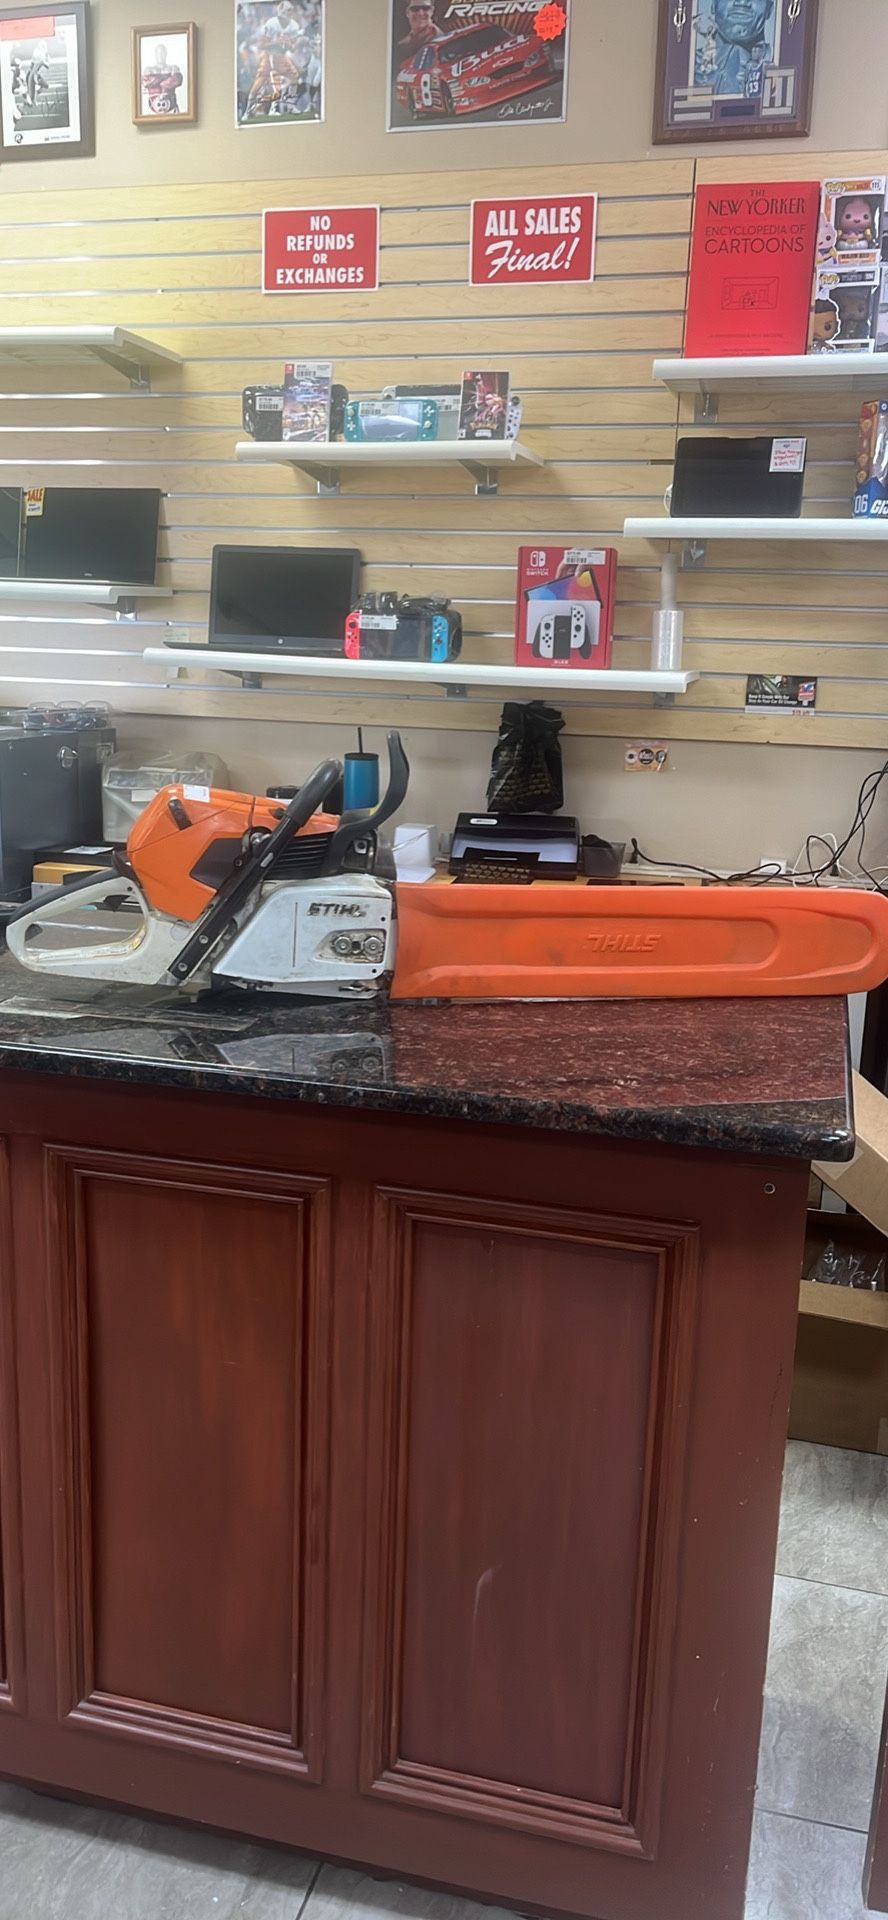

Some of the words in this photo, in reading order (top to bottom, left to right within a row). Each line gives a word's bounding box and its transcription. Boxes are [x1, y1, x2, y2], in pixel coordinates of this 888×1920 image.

[444, 1, 550, 18] RACING
[452, 34, 529, 77] Bud
[420, 73, 433, 107] 8
[707, 199, 743, 216] NEW
[743, 197, 806, 216] YORKER
[310, 215, 331, 231] NO
[485, 209, 519, 237] ALL
[524, 206, 582, 236] SALES
[705, 225, 788, 236] ENCYCLOPEDIA
[790, 224, 806, 235] OF
[286, 233, 355, 252] REFUNDS
[704, 237, 805, 255] CARTOONS
[312, 253, 328, 265] OR
[484, 237, 580, 279] Final!
[276, 266, 365, 285] EXCHANGES
[27, 488, 43, 502] SALE
[854, 494, 868, 514] 06
[307, 902, 367, 918] STIHL
